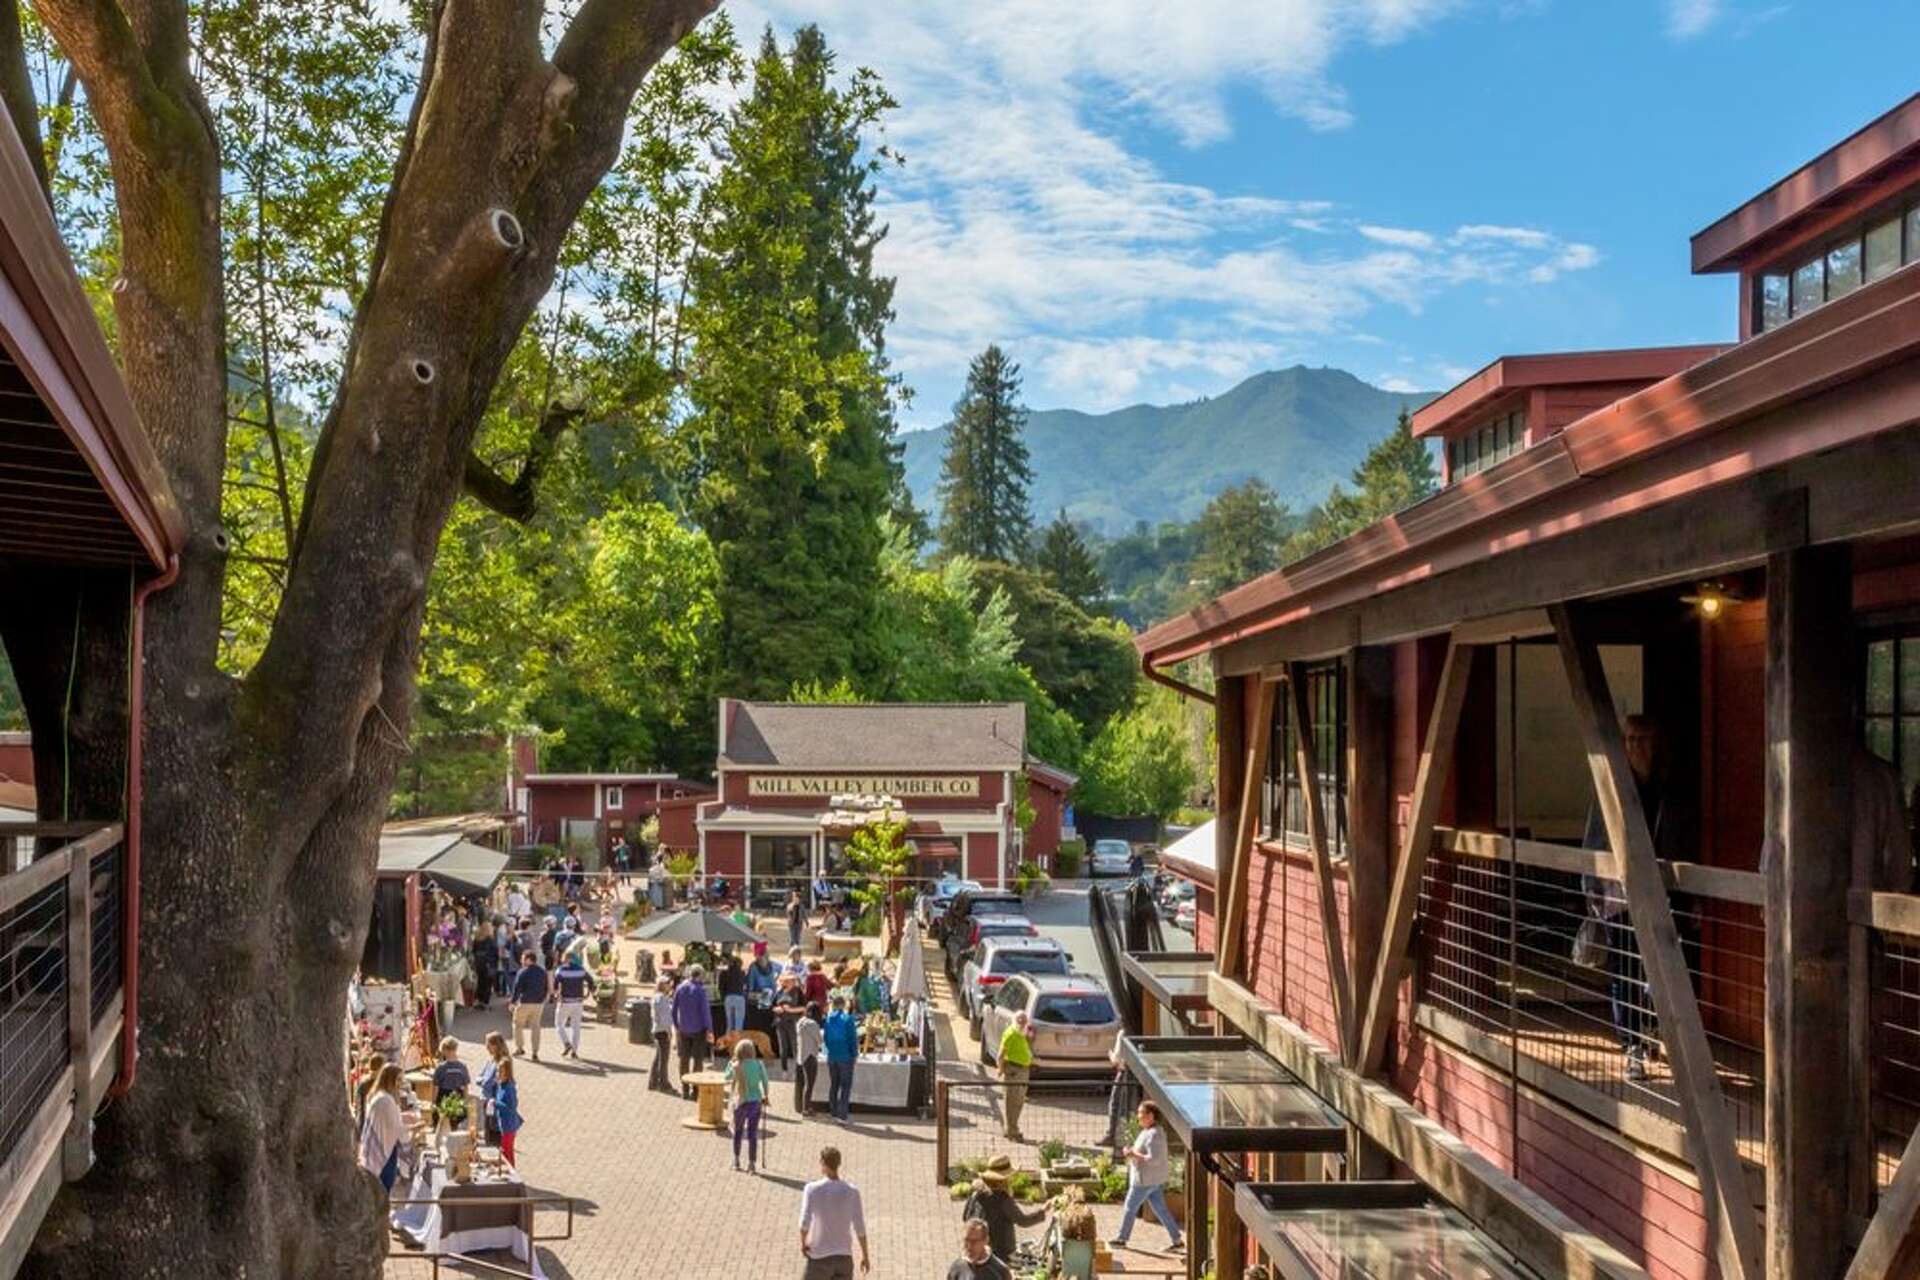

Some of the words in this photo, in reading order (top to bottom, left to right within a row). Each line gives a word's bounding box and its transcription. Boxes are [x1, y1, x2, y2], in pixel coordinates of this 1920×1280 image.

[755, 779, 796, 793] MILL
[800, 779, 865, 793] VALLEY
[872, 779, 944, 793] LUMBER
[949, 779, 972, 793] CO
